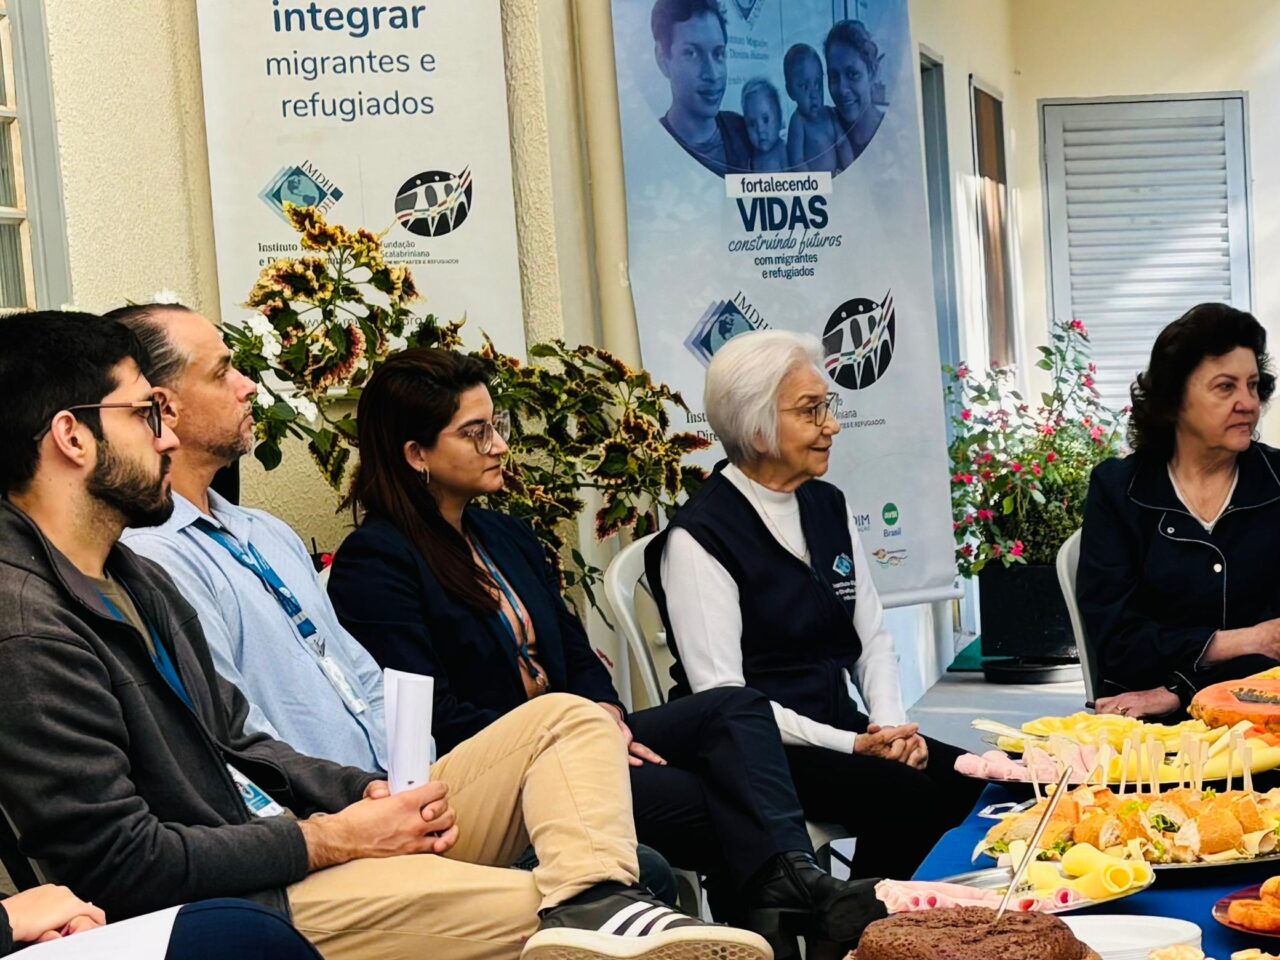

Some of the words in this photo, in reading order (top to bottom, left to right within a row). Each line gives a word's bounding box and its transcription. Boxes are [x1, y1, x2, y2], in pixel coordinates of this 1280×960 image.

[273, 0, 426, 38] integrar
[266, 50, 410, 80] migrantes
[420, 53, 436, 72] e
[282, 90, 435, 121] refugiados
[301, 159, 334, 192] IMDH
[741, 175, 819, 193] fortalecendo
[736, 194, 829, 232] VIDAS
[258, 243, 298, 253] Instituto
[728, 229, 797, 252] construindo
[798, 228, 842, 254] futuros
[754, 256, 773, 266] com
[774, 253, 818, 266] migrantes
[769, 265, 815, 280] refugiados
[883, 527, 901, 537] Brasil
